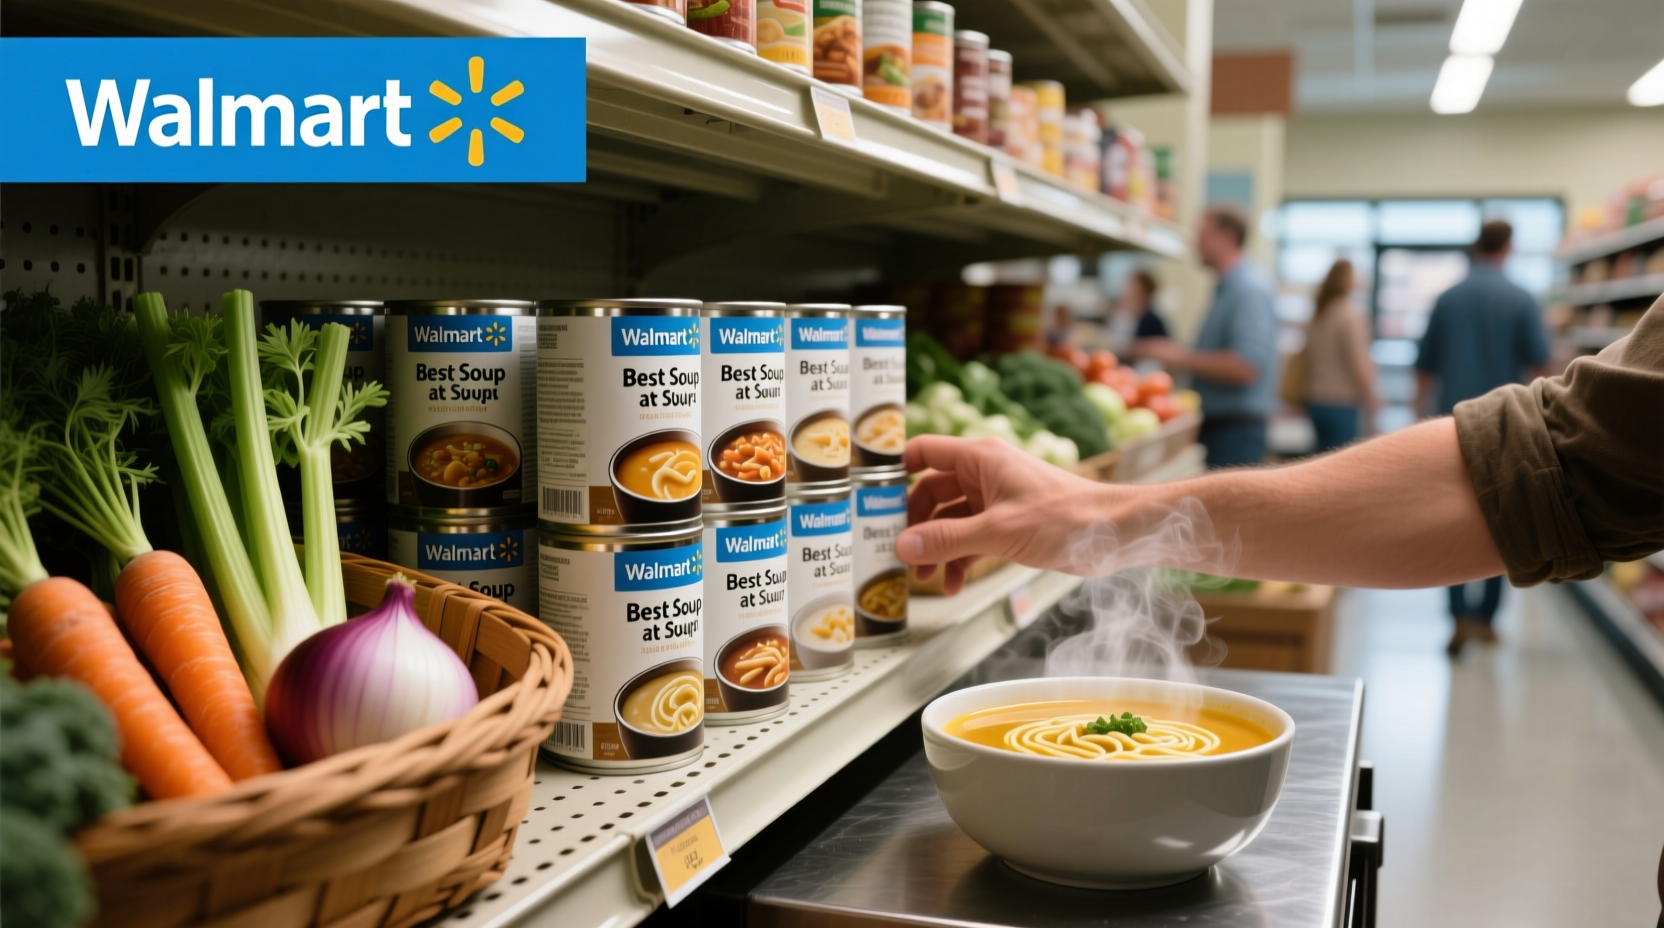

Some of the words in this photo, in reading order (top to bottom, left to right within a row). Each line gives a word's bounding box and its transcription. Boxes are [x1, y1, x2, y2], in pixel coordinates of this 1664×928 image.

[414, 325, 483, 343] Walmart
[621, 328, 688, 346] Walmart
[719, 328, 775, 345] Walmart
[416, 363, 455, 381] Best
[459, 363, 506, 386] Soup
[623, 368, 665, 387] Best
[669, 367, 700, 389] Soup
[721, 364, 757, 382] Best
[760, 364, 784, 384] Soup
[429, 384, 446, 401] at
[639, 391, 658, 408] at
[735, 385, 751, 400] at
[425, 544, 496, 561] Walmart
[802, 545, 831, 562] Best
[625, 559, 691, 581] Walmart
[814, 565, 827, 578] at
[726, 572, 762, 591] Best
[740, 593, 756, 608] at
[627, 601, 669, 622] Best
[672, 598, 702, 617] Soup
[642, 624, 660, 641] at
